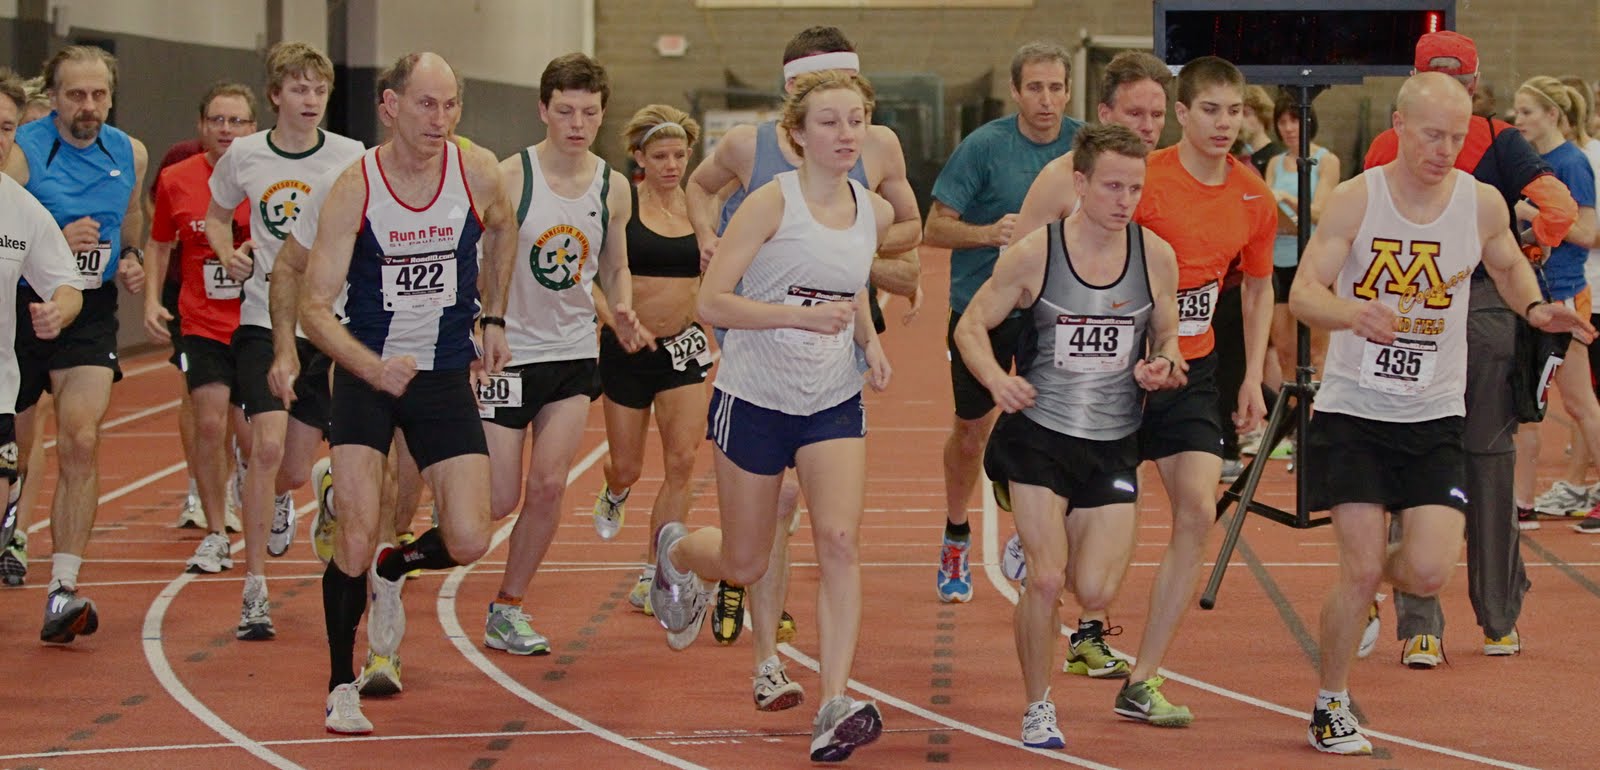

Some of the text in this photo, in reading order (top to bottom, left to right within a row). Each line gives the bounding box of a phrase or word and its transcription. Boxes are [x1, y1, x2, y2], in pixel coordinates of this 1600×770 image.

[389, 225, 454, 242] Run n Fun
[536, 226, 573, 247] MINNESOTA
[395, 263, 444, 290] 422
[1353, 237, 1453, 309] M
[1069, 326, 1119, 352] 443
[1413, 317, 1445, 335] FIELD
[673, 331, 706, 360] 425
[1375, 347, 1424, 376] 435
